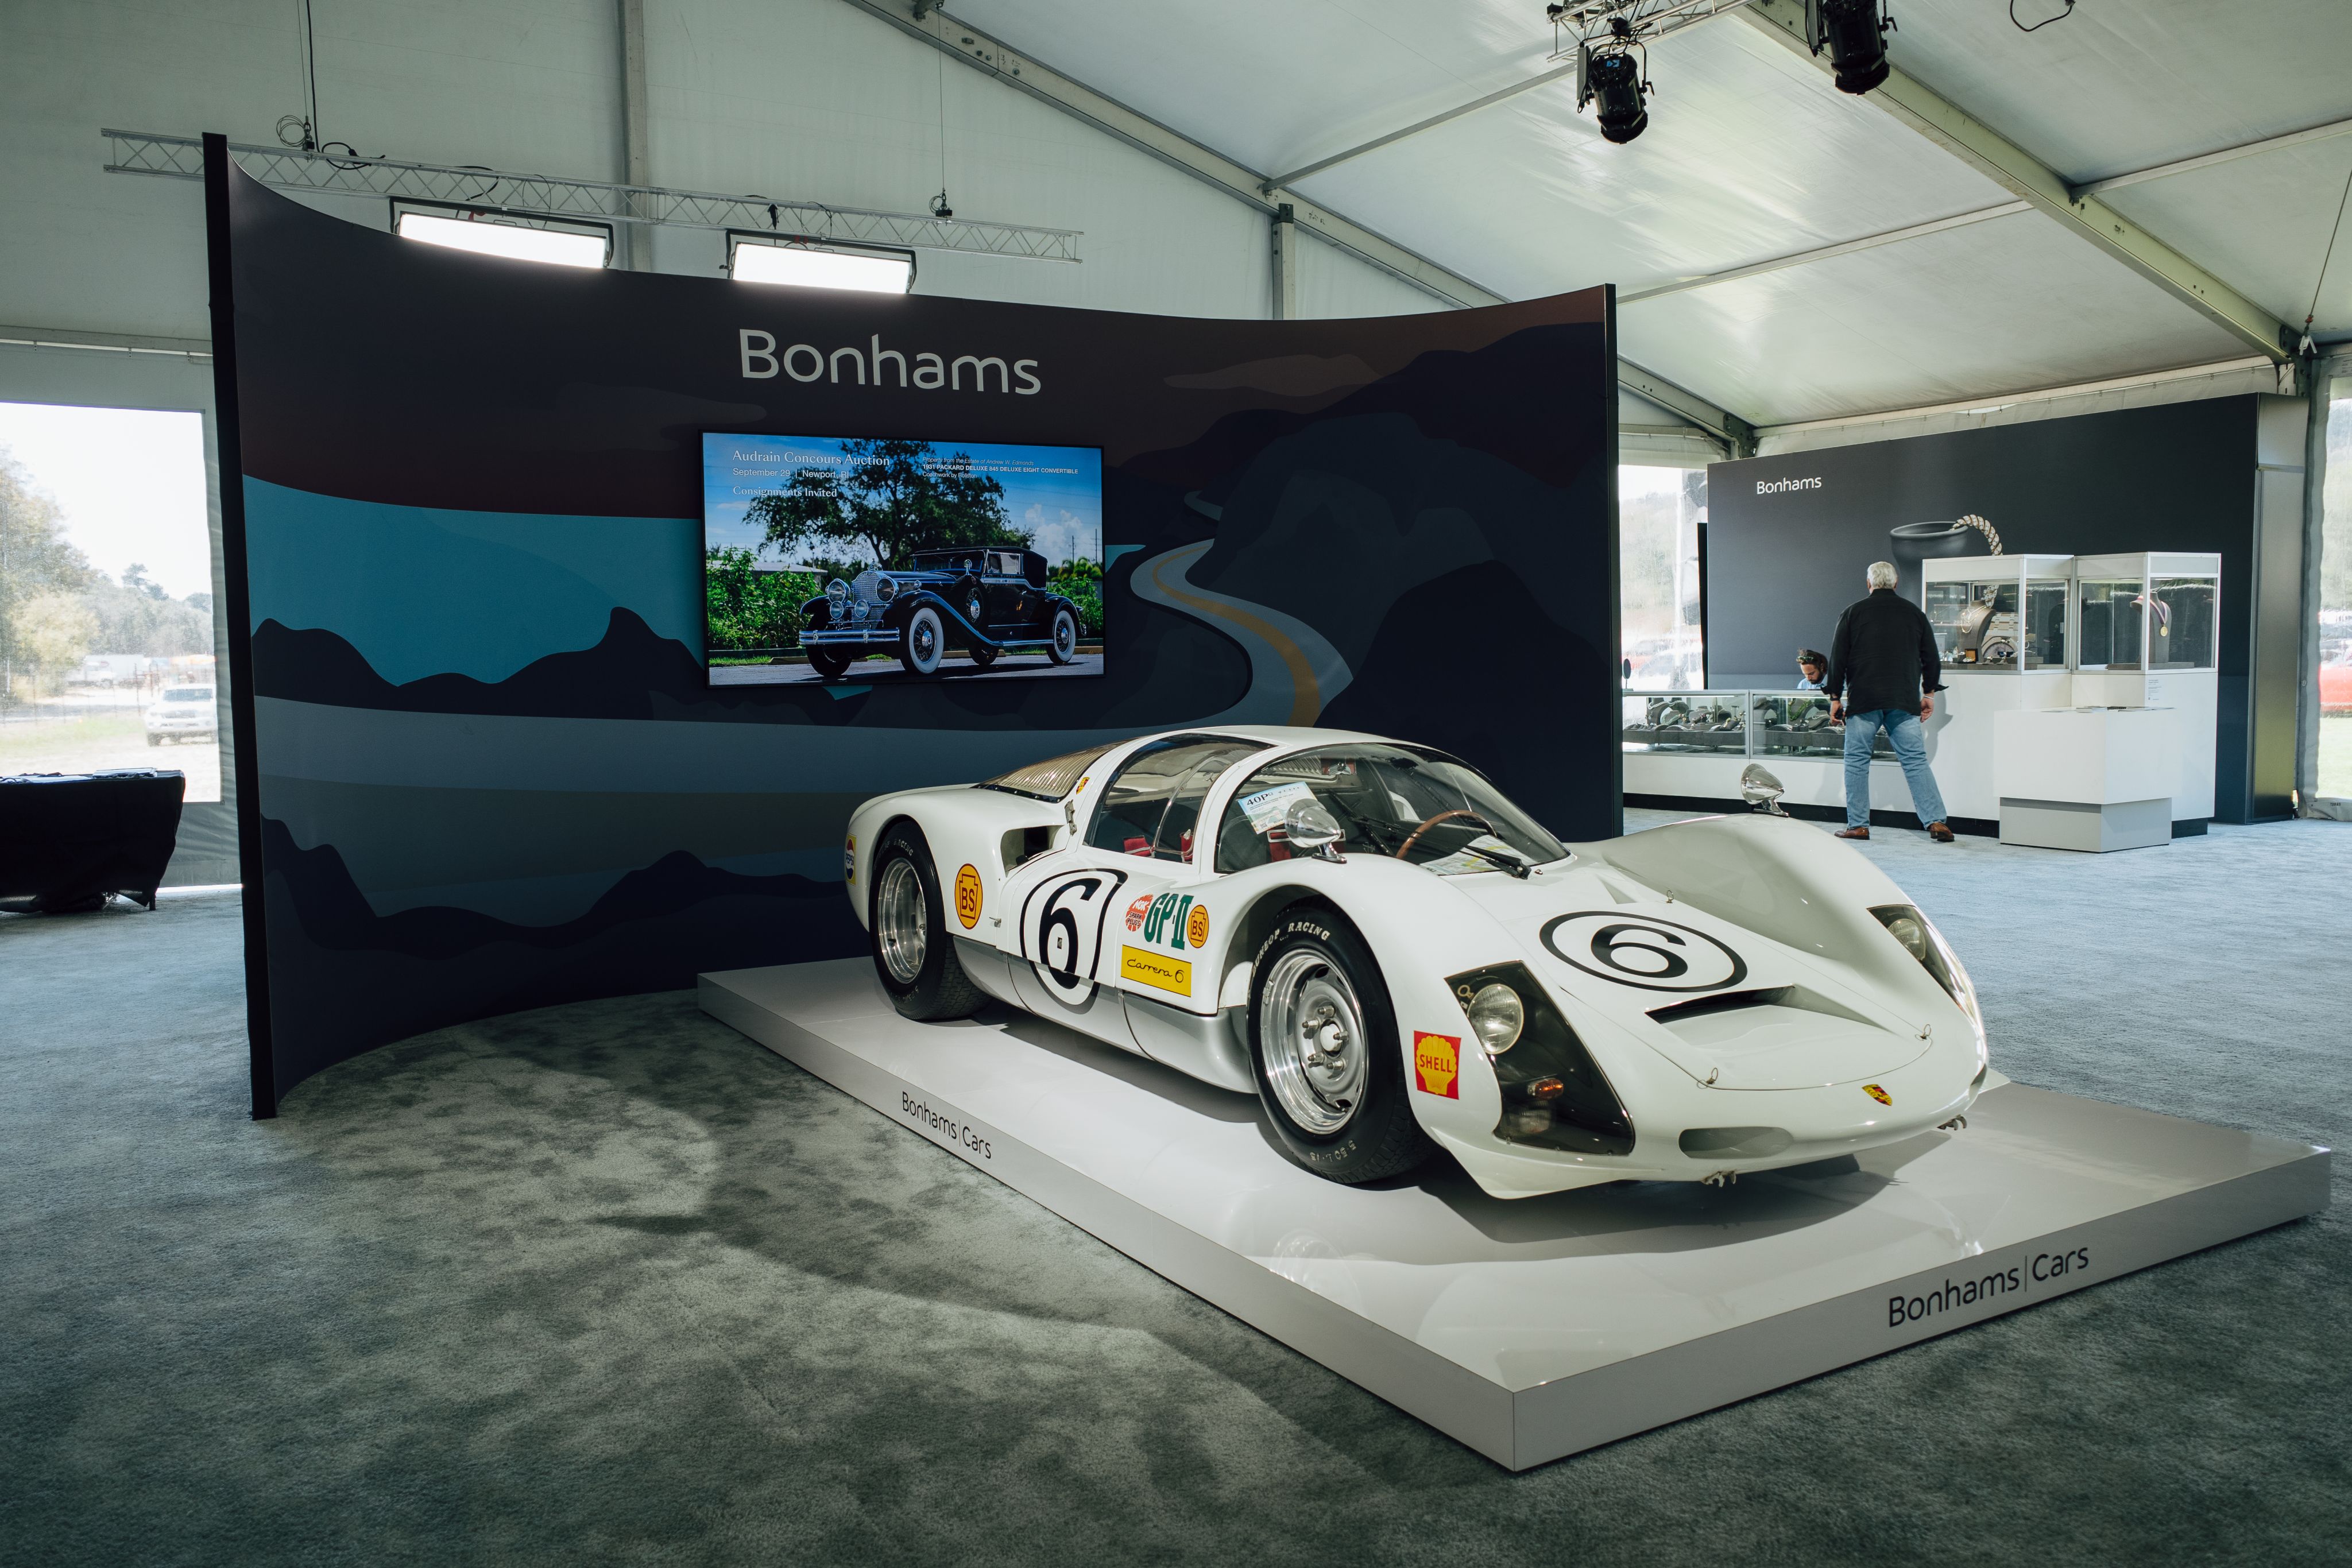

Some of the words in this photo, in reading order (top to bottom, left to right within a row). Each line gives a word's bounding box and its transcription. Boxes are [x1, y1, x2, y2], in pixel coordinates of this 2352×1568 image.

[740, 329, 1041, 394] Bonhams
[733, 450, 780, 462] Audrain
[784, 452, 841, 464] Concours
[845, 454, 889, 466] Auction
[733, 468, 778, 477] September
[802, 470, 838, 479] Newport,
[733, 486, 802, 498] Consignments
[805, 488, 837, 497] Invited
[1757, 477, 1822, 494] Bonhams
[846, 853, 854, 866] PEPSI
[962, 887, 974, 912] BS
[1132, 900, 1150, 911] NGK
[1127, 918, 1141, 927] PLUGS
[1129, 912, 1142, 920] SPARK
[1039, 878, 1102, 989] 6
[1192, 920, 1204, 937] BS
[1252, 928, 1280, 977] DUNLOP
[1288, 922, 1330, 940] RACING
[1591, 924, 1688, 978] 6
[1127, 958, 1173, 977] Carrera
[1175, 969, 1185, 983] 6
[1419, 1054, 1452, 1073] SHELL
[902, 1091, 957, 1140] Bonhams
[962, 1126, 991, 1159] Cars
[1889, 1267, 2020, 1327] Bonhams
[2032, 1247, 2088, 1281] Cars
